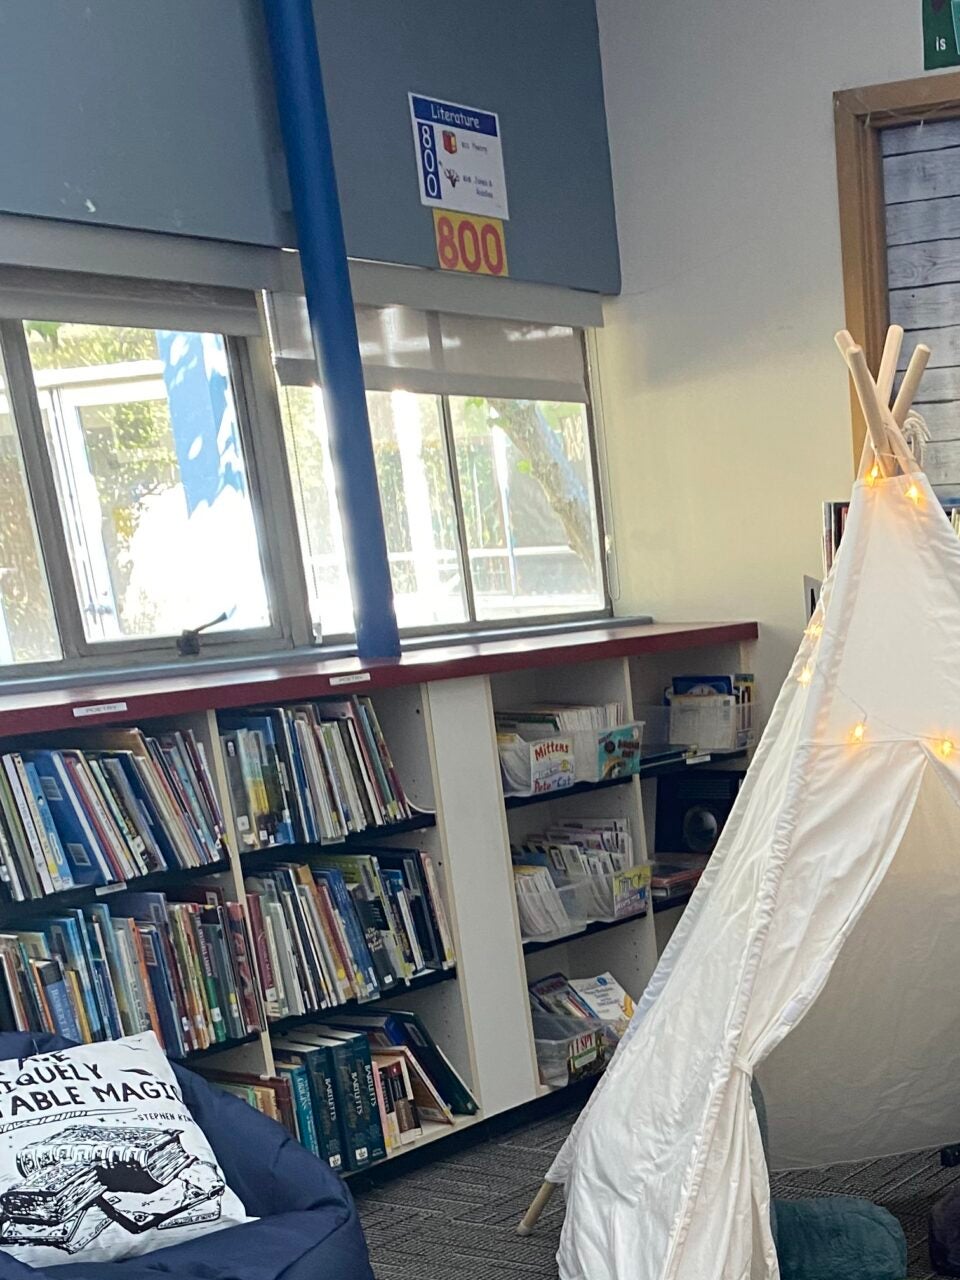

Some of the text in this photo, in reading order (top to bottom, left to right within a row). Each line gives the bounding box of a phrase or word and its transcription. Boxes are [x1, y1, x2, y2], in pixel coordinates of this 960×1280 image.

[935, 36, 946, 51] is
[431, 103, 480, 128] Literature
[437, 215, 504, 275] 800
[534, 742, 568, 760] Mittens
